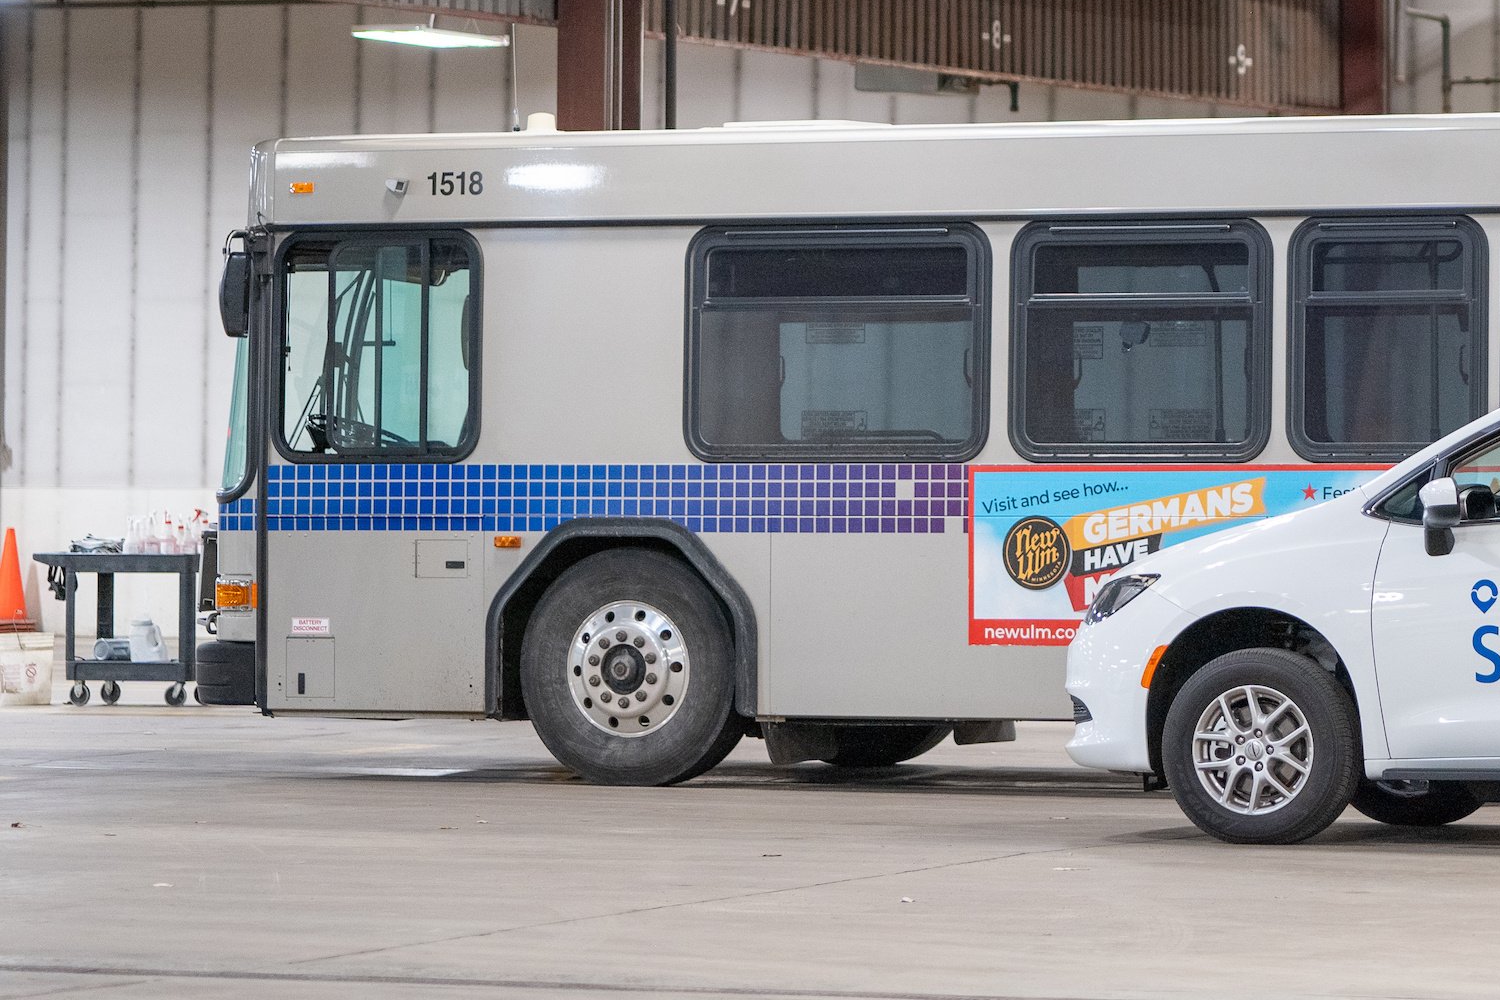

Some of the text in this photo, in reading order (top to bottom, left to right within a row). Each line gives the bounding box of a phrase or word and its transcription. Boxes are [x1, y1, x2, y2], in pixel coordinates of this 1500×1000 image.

[427, 170, 484, 196] 1518
[982, 481, 1129, 514] Visit and see how...
[1083, 483, 1254, 544] GERMANS
[1084, 538, 1149, 571] HAVE
[984, 624, 1080, 639] newulm.co
